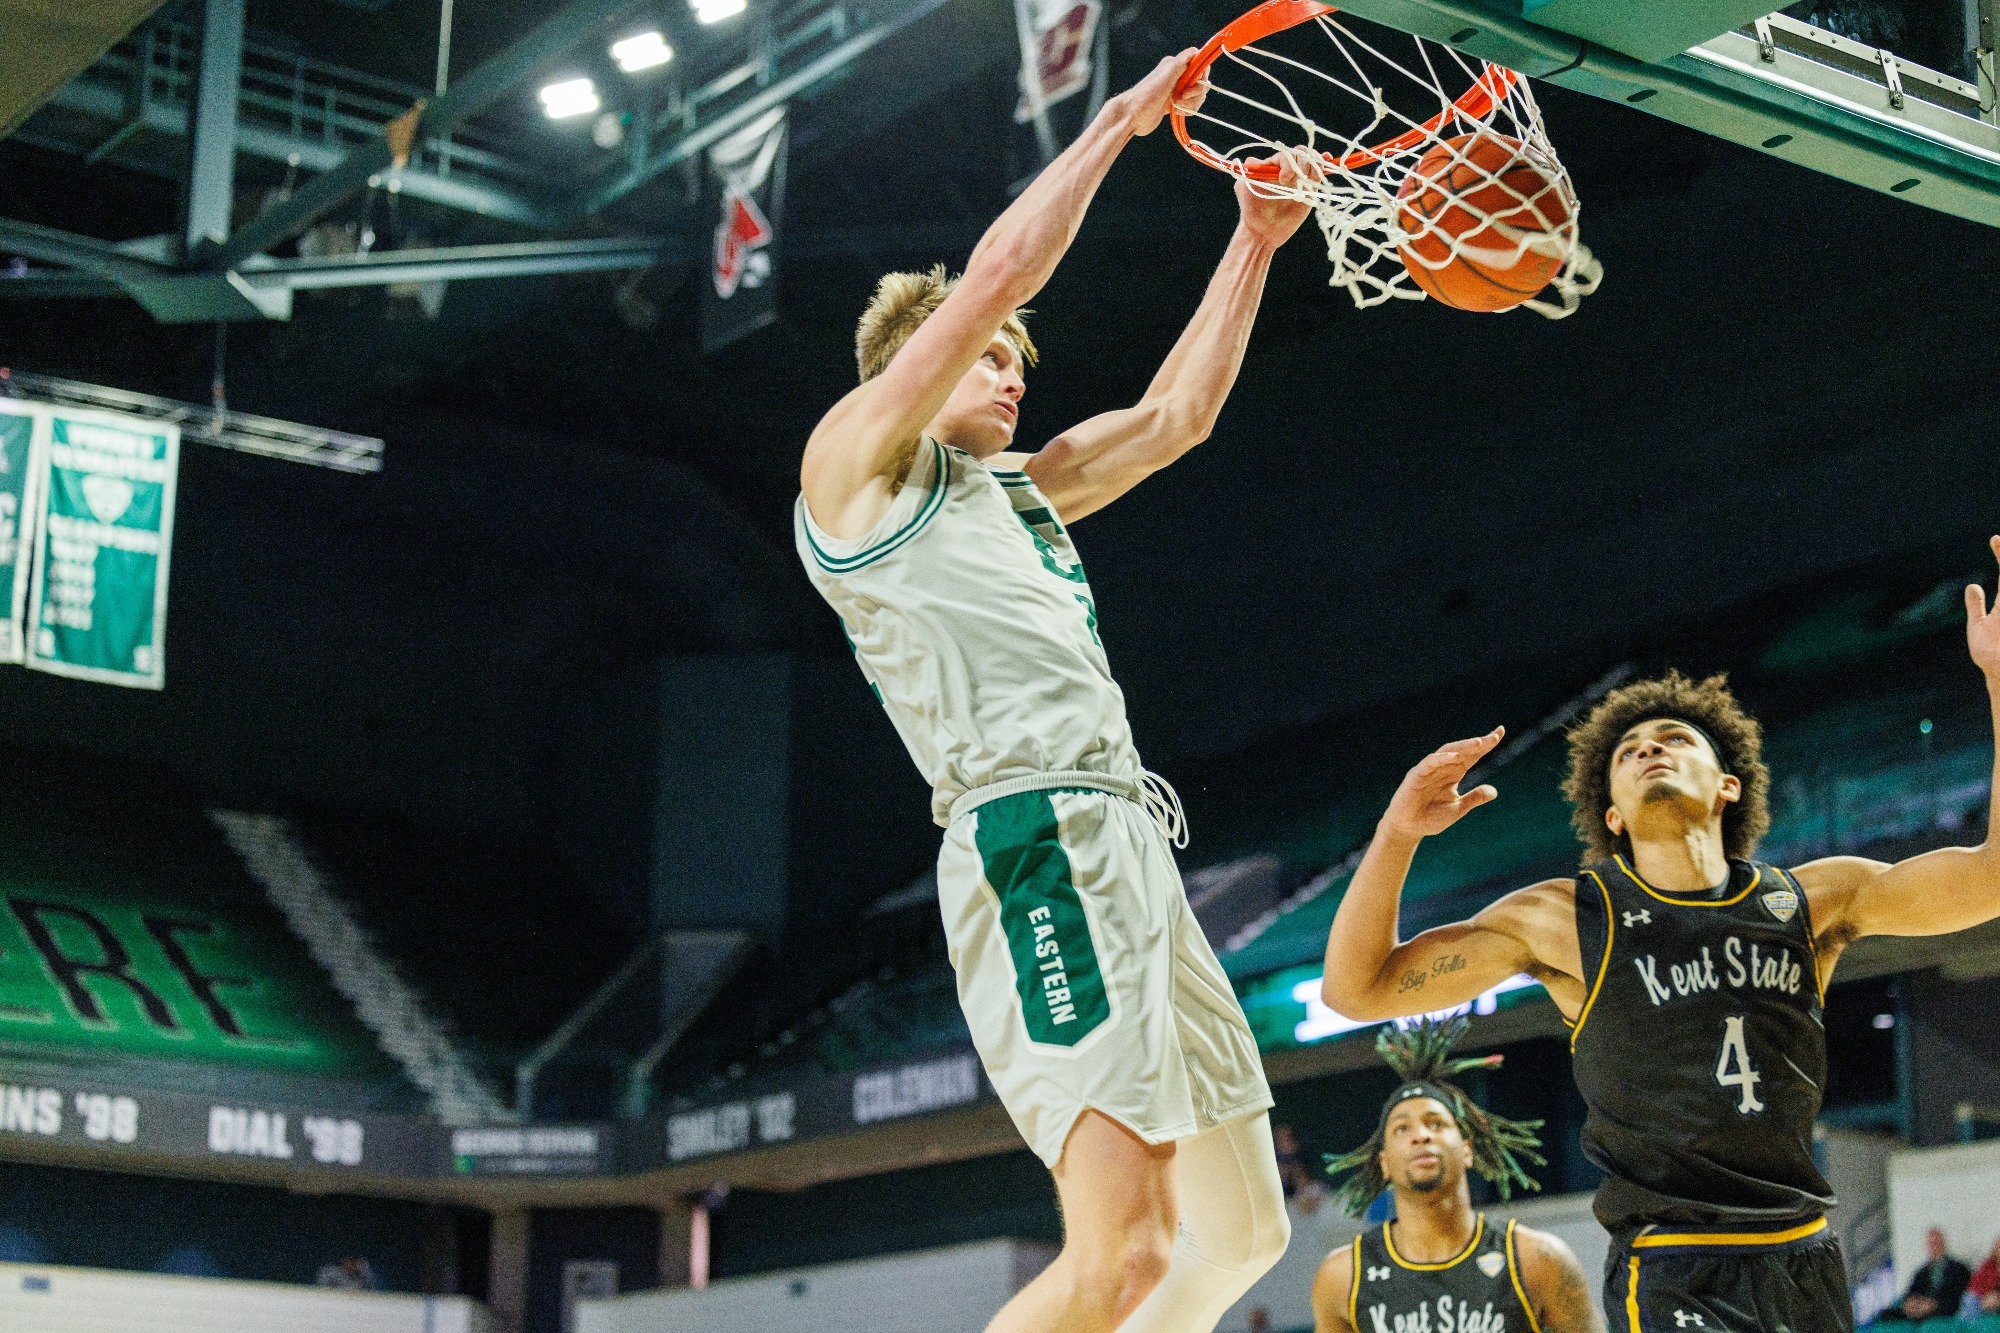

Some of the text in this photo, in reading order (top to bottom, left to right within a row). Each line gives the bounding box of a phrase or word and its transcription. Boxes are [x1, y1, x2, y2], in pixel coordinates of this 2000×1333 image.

[1027, 905, 1077, 1026] EASTERN
[1397, 953, 1467, 994] Big Fella
[1633, 936, 1802, 1007] Kent State
[1715, 1015, 1765, 1116] 4
[207, 1104, 294, 1159] DIAL
[1368, 1294, 1507, 1333] Kent State
